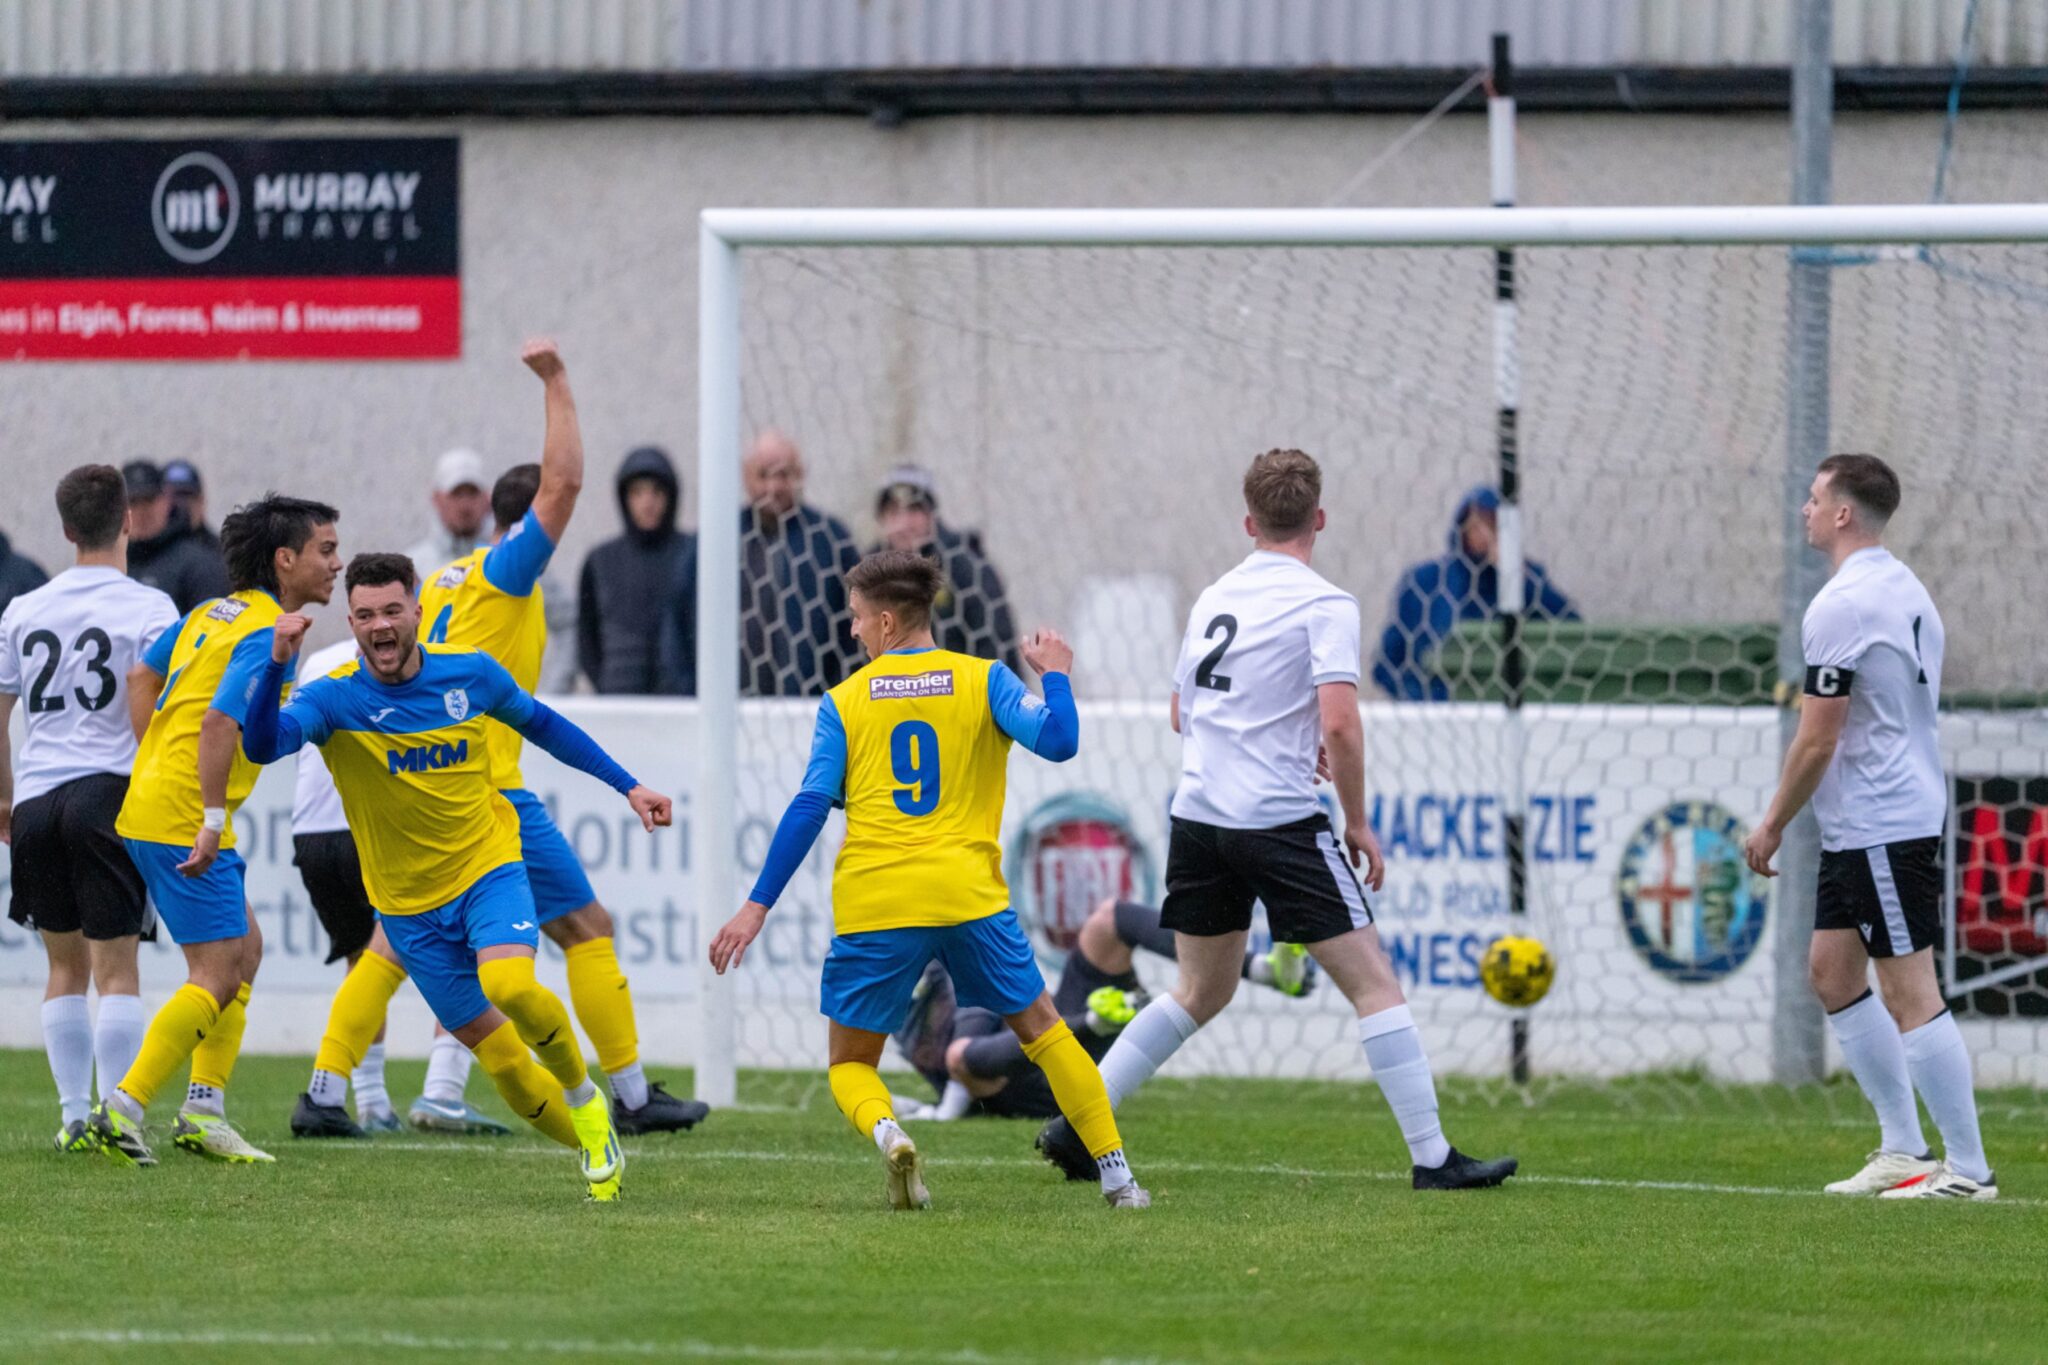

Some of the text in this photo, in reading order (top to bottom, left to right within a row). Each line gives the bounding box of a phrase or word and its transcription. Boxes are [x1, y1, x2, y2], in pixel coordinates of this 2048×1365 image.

[0, 175, 57, 215] AY
[165, 183, 223, 234] mt
[253, 171, 422, 212] MURRAY
[253, 212, 422, 241] TRAVEL
[58, 302, 126, 341] Elgin,
[303, 301, 422, 333] Inverness
[22, 627, 117, 713] 23
[1195, 613, 1238, 693] 2
[871, 673, 951, 692] Premier
[871, 687, 952, 699] GRANTOWN ON SPEY
[1816, 666, 1840, 695] C
[387, 739, 468, 776] MKM
[889, 720, 941, 817] 9
